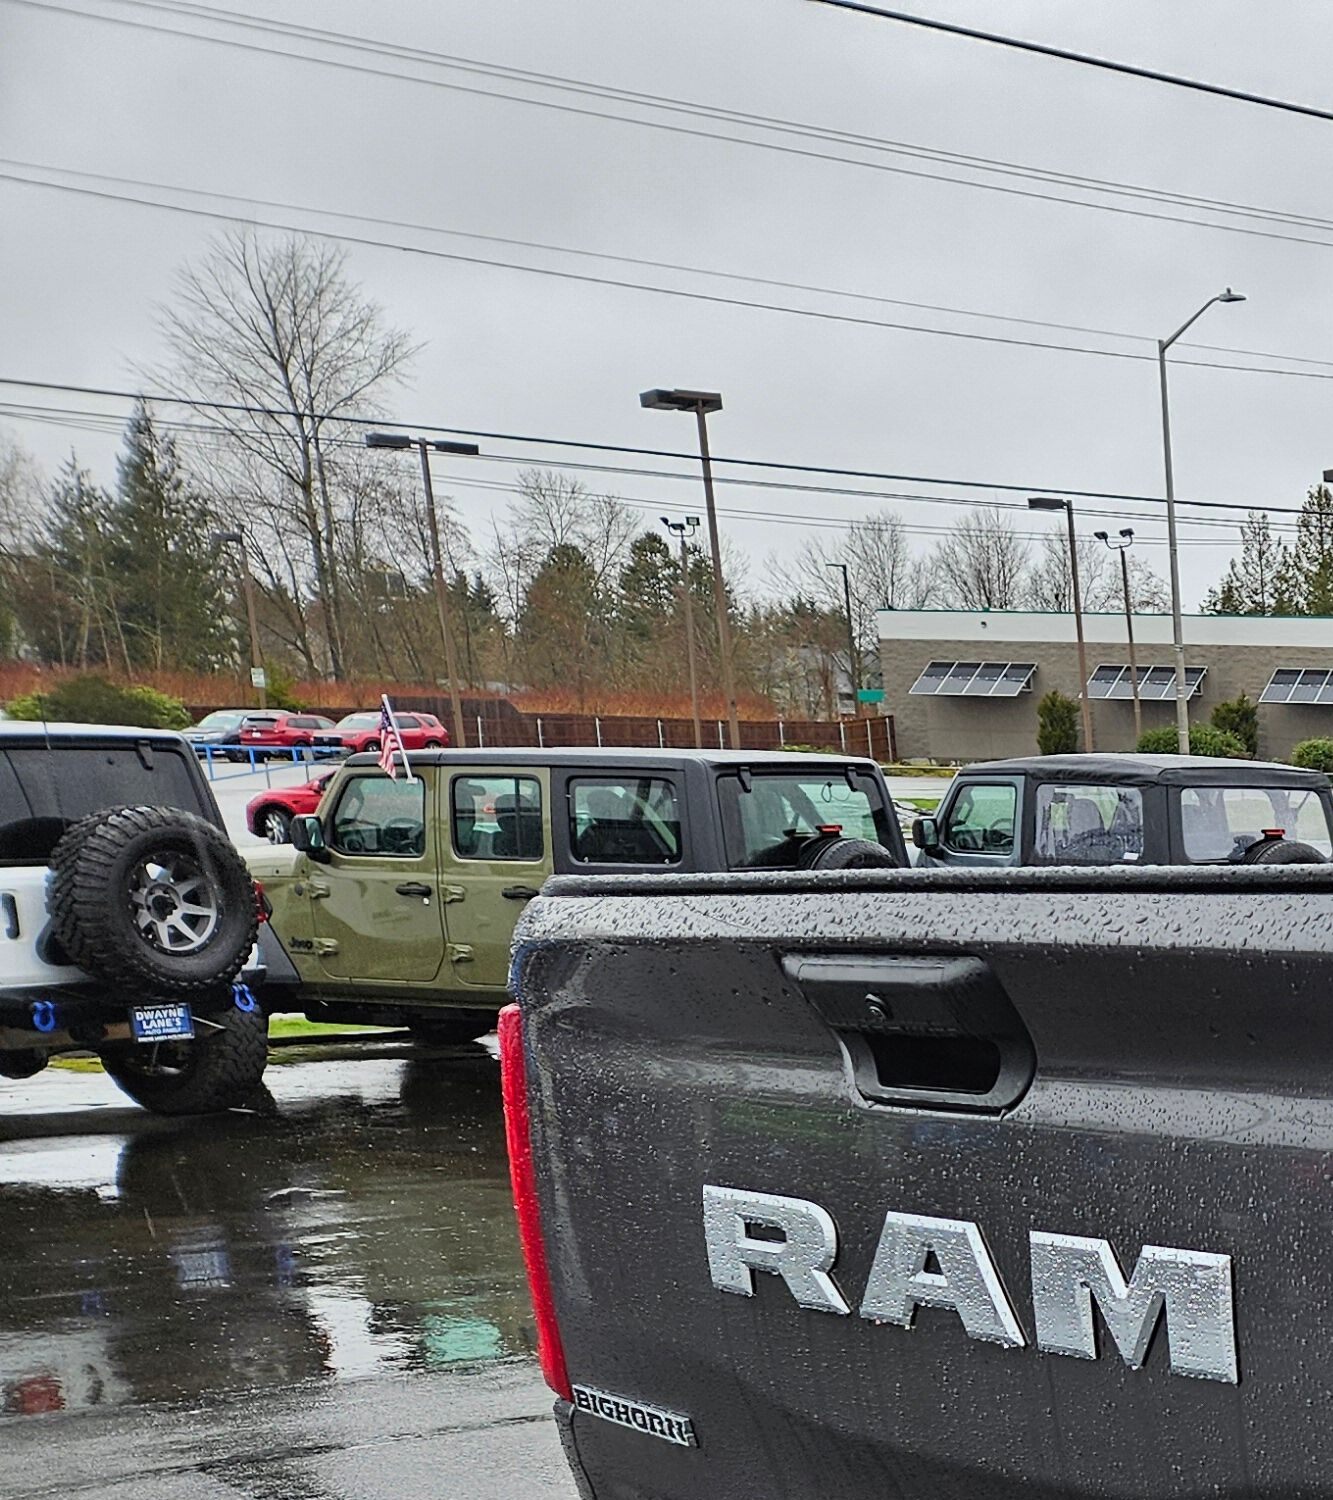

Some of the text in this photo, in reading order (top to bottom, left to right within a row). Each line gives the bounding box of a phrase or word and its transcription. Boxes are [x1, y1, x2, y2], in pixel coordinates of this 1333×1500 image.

[135, 1007, 185, 1021] DWAYNE
[142, 1018, 182, 1030] LANE'S
[703, 1184, 1240, 1386] RAM
[574, 1387, 688, 1443] BIGHORN
